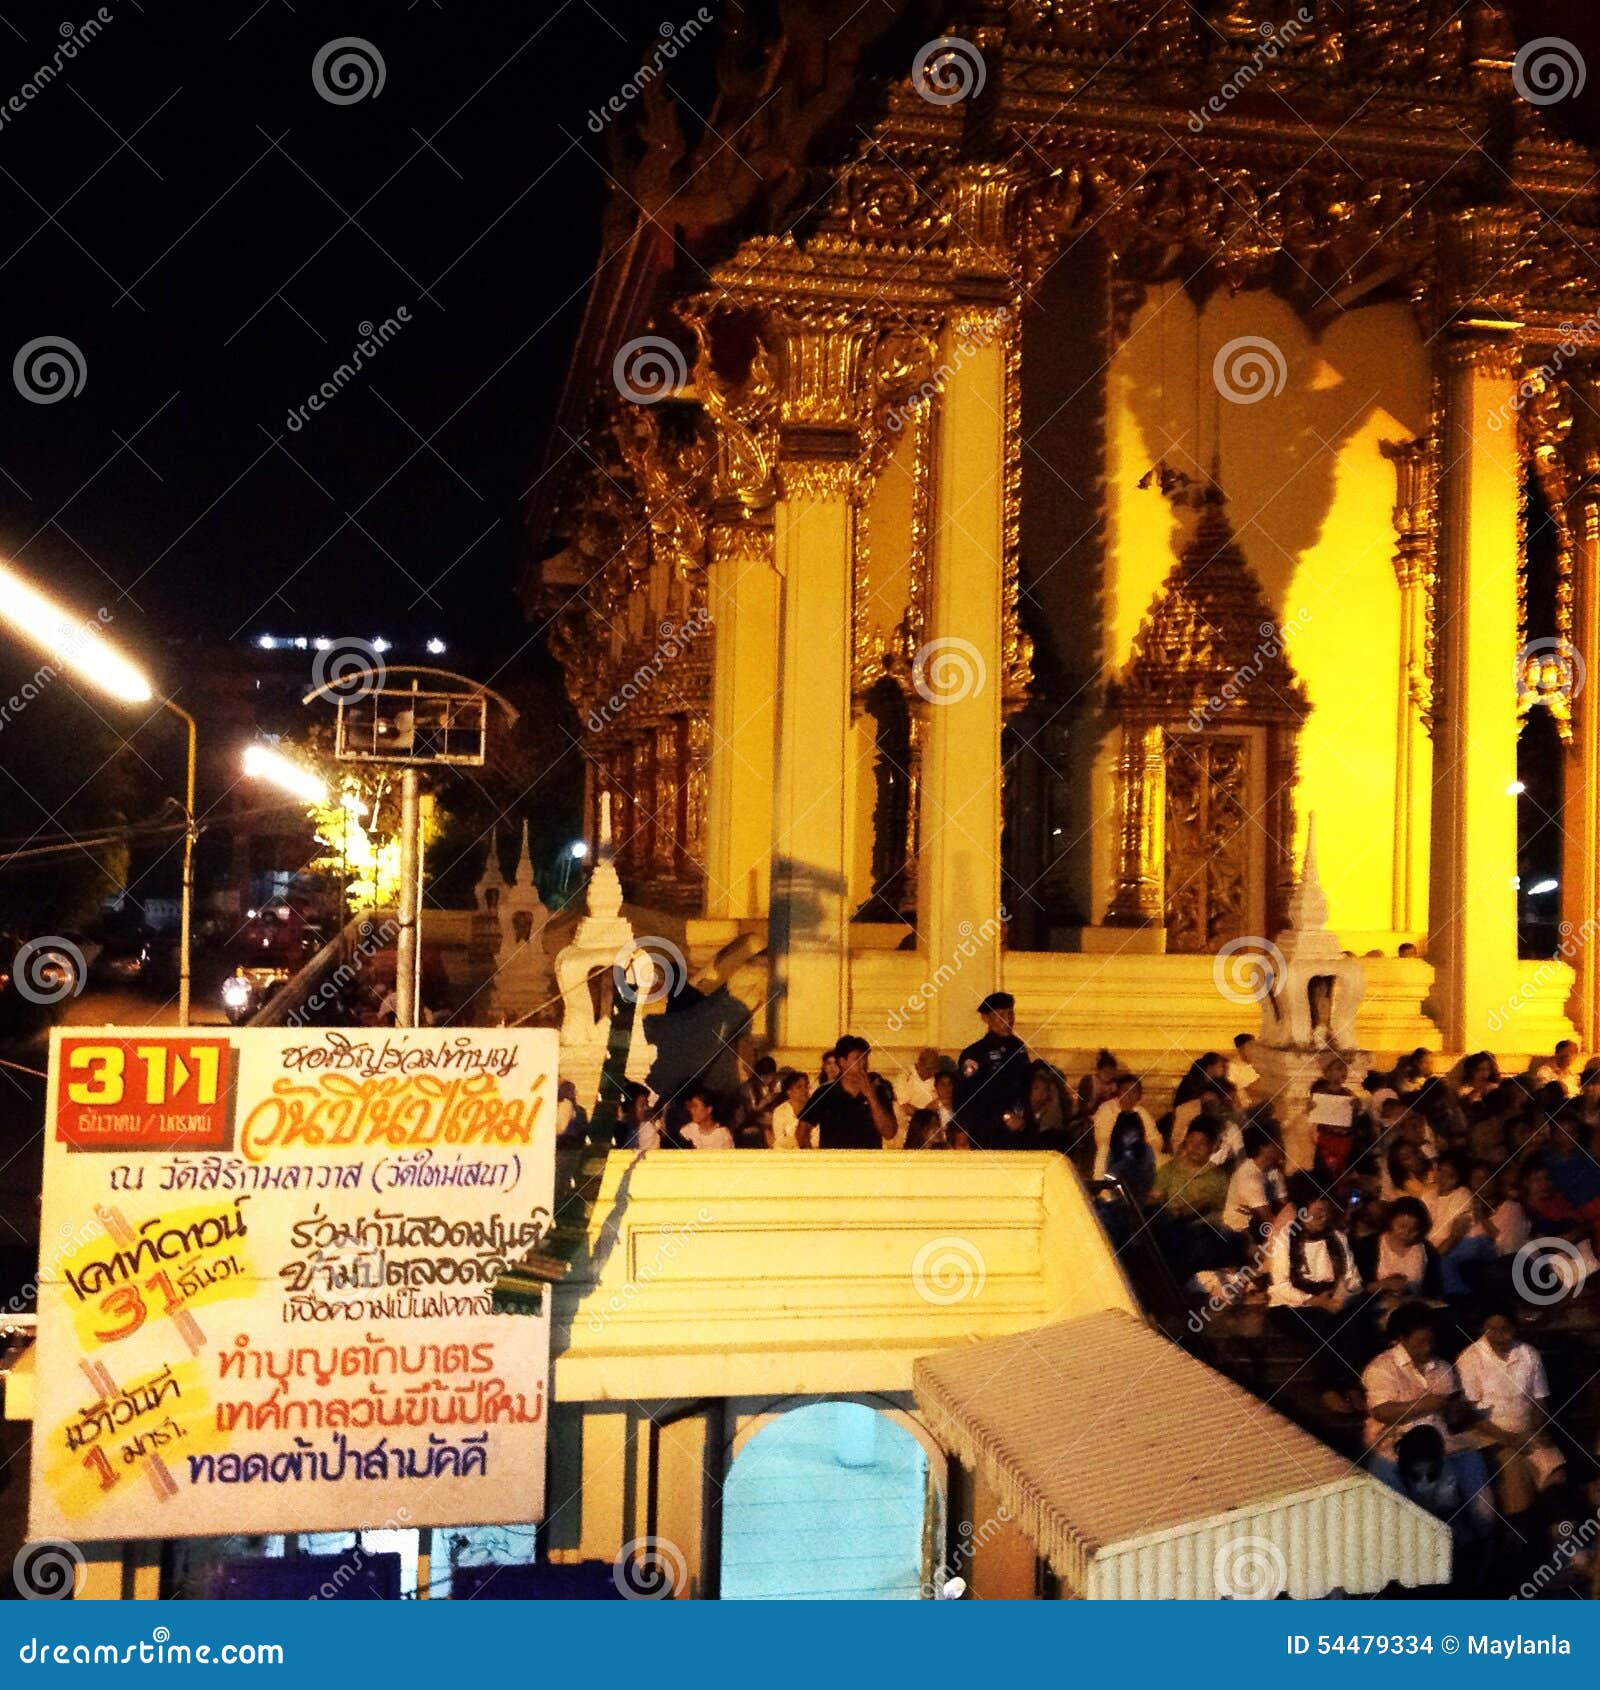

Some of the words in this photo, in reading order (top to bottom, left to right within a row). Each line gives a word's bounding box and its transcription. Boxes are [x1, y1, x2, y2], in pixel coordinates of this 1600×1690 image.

[278, 1249, 516, 1292] ข้ามปีตลอดคื
[94, 1269, 184, 1343] 31
[218, 1332, 496, 1390] ทำบุญตักบาตร
[215, 1378, 545, 1432] เทศกาลวันขึ้นปีใหม่
[187, 1431, 489, 1484] ทอดผ้าป่าสามัคคี
